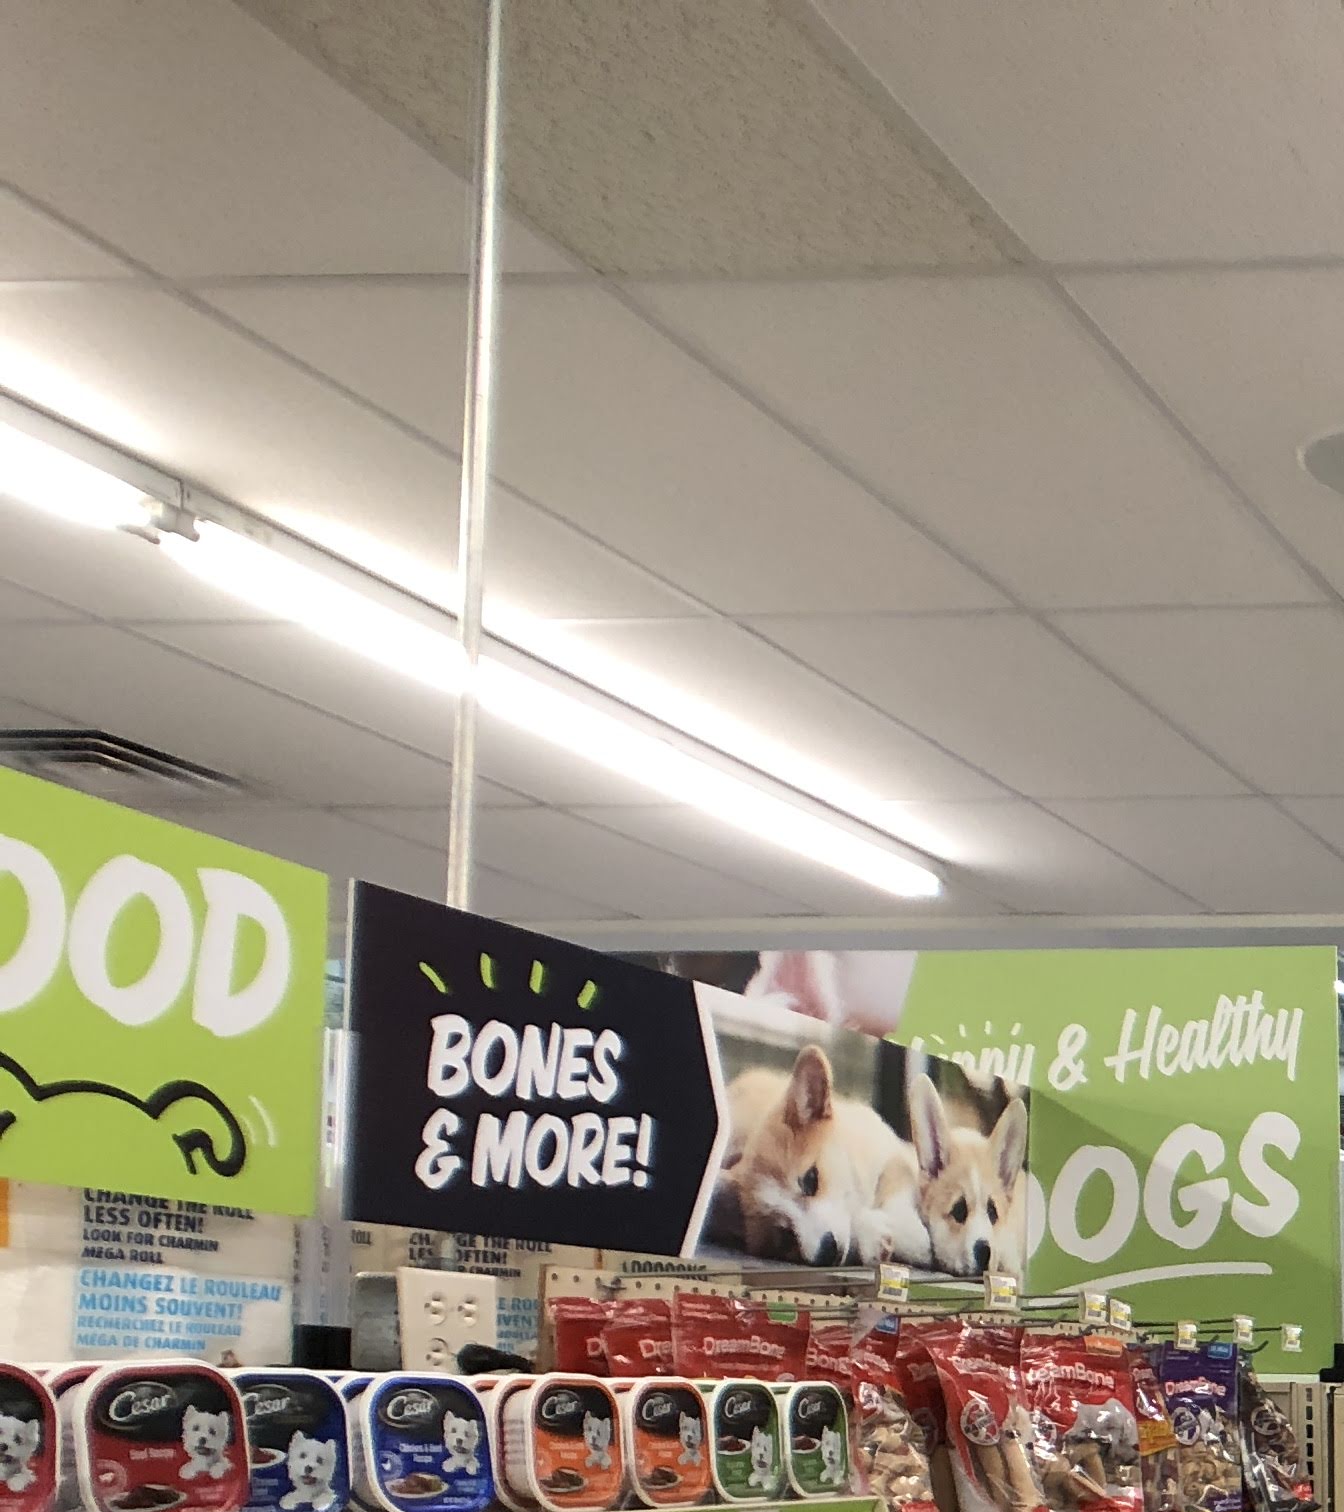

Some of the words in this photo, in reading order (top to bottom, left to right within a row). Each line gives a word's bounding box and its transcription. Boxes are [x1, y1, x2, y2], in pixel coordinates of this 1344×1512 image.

[1047, 1023, 1088, 1092] &
[1104, 990, 1304, 1083] Healthy
[429, 1014, 624, 1103] BONES
[415, 1112, 462, 1189] &
[471, 1113, 652, 1189] MORE!
[84, 1207, 131, 1226] LESS
[137, 1210, 205, 1233] OFTEN!
[79, 1269, 174, 1293] CHANGEZ
[180, 1278, 198, 1295] LE
[204, 1280, 282, 1301] ROULEAU
[79, 1294, 149, 1314] MOINS
[109, 1391, 172, 1421] Cesar
